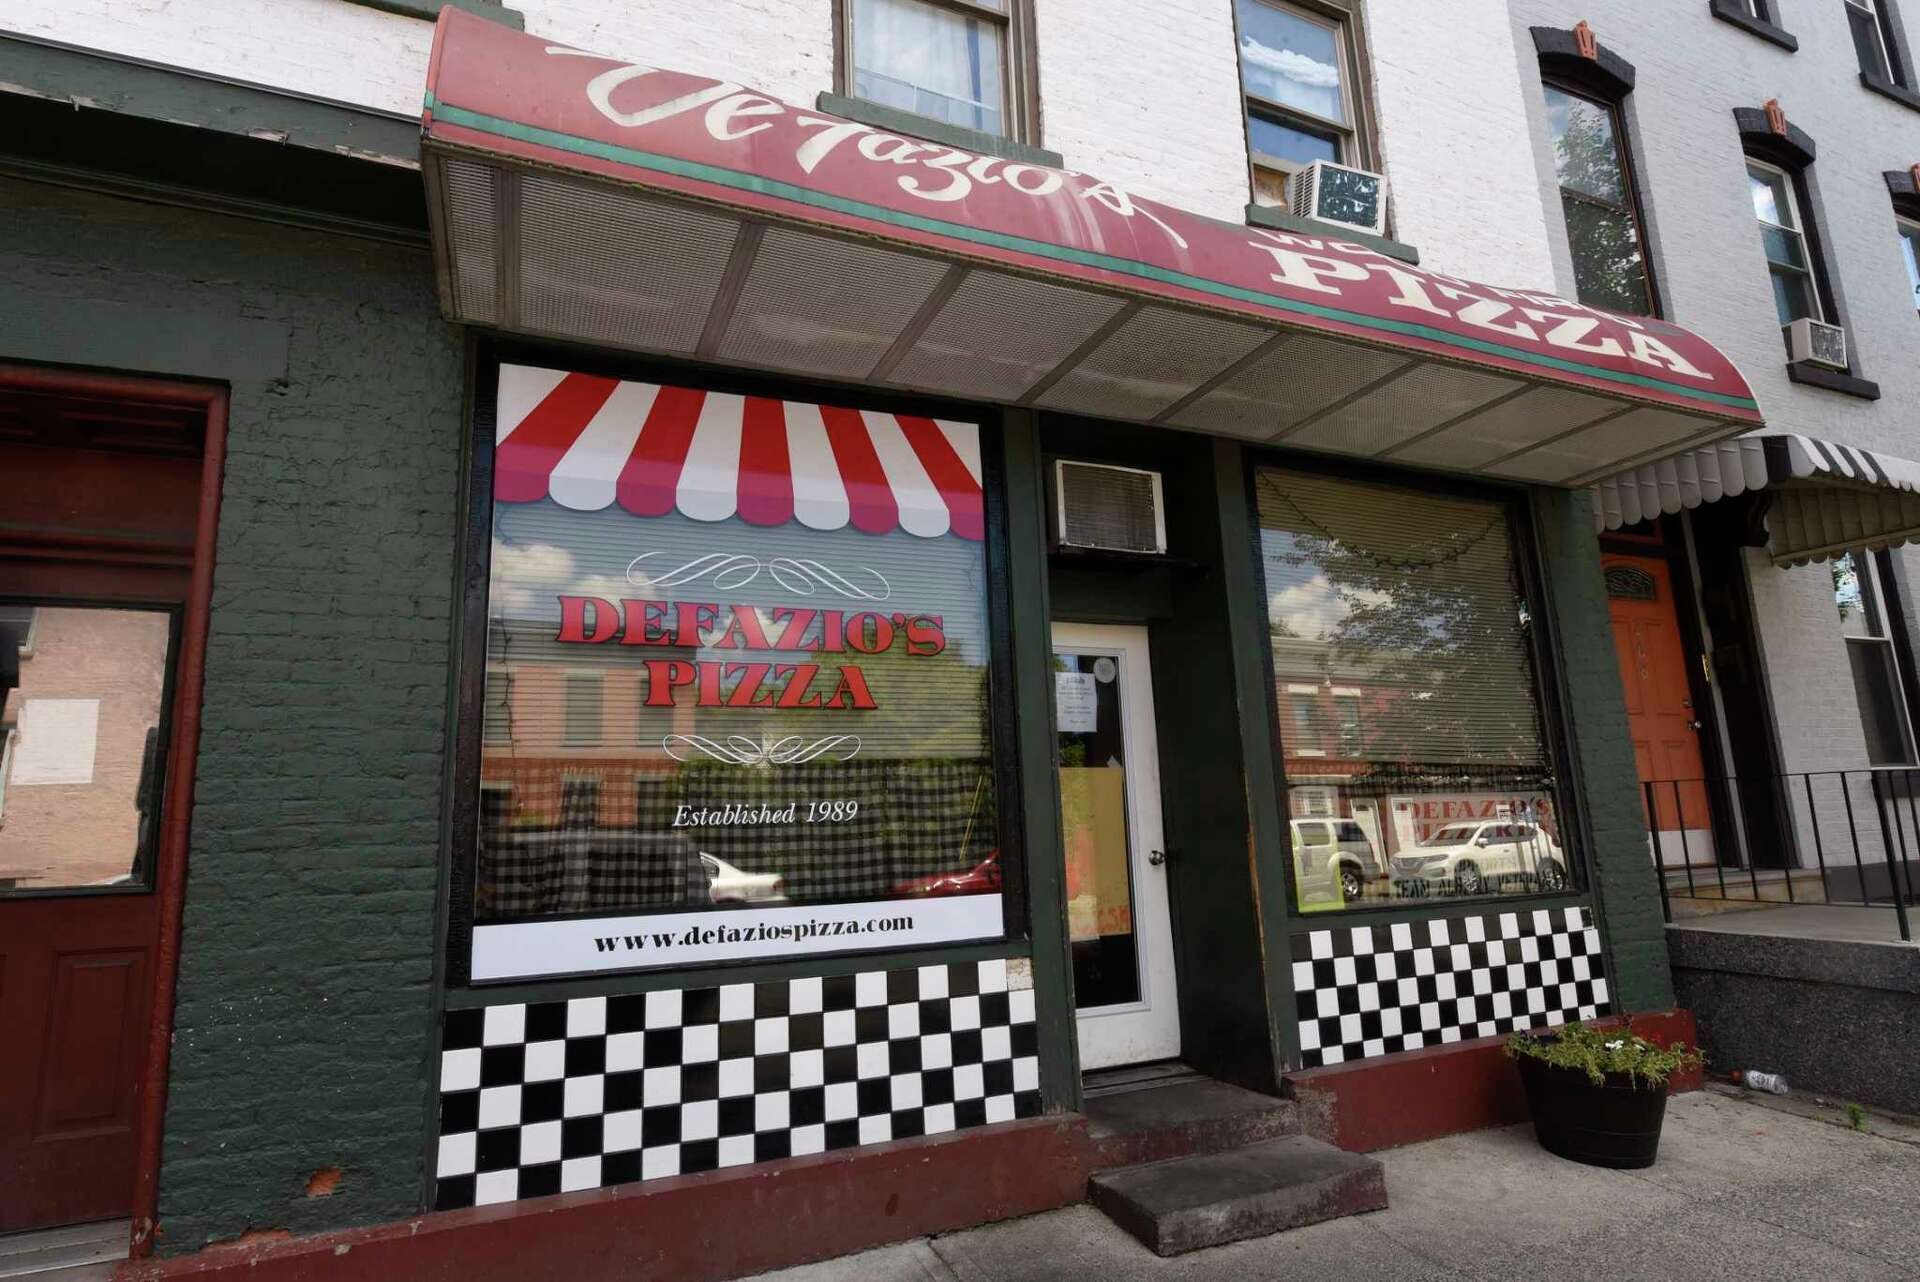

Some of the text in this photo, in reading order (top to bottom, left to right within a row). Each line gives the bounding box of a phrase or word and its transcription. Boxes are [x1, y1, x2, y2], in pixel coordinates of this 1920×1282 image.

[1248, 241, 1714, 380] PIZZA
[555, 595, 947, 656] DEFAZIO'S
[642, 659, 879, 710] PIZZA
[673, 800, 858, 827] Established 1989
[594, 916, 915, 952] www.defaziospizza.com
